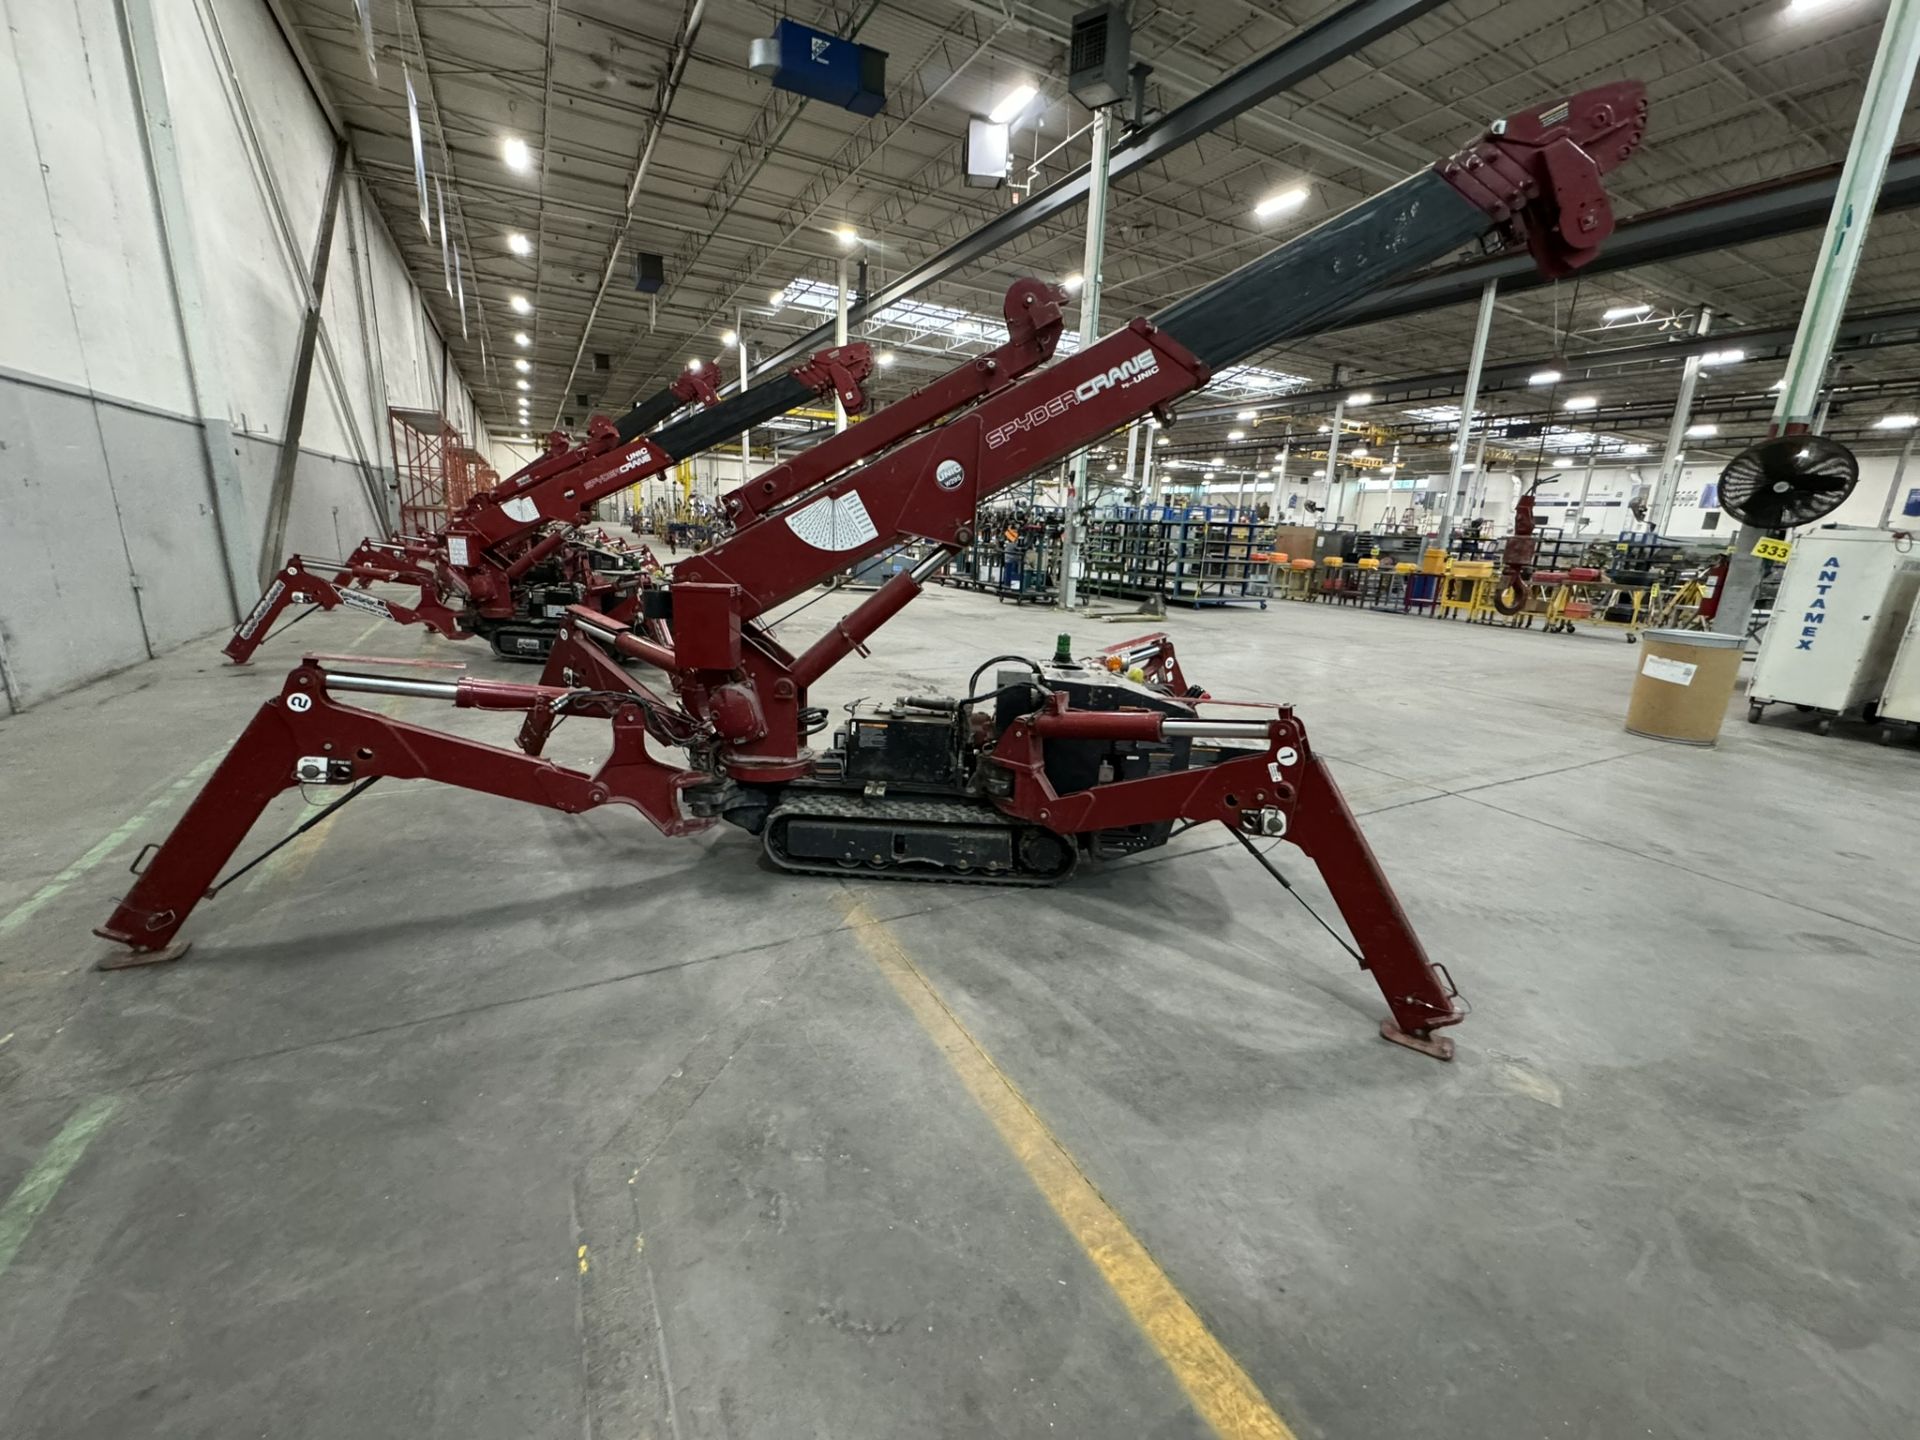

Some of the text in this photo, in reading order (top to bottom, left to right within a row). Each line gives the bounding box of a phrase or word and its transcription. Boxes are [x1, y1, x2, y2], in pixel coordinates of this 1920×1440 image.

[1133, 365, 1160, 385] UNIC
[937, 464, 962, 482] UNIC
[1757, 543, 1788, 559] 333
[1795, 556, 1840, 651] ANTAMEX
[291, 695, 309, 709] 2
